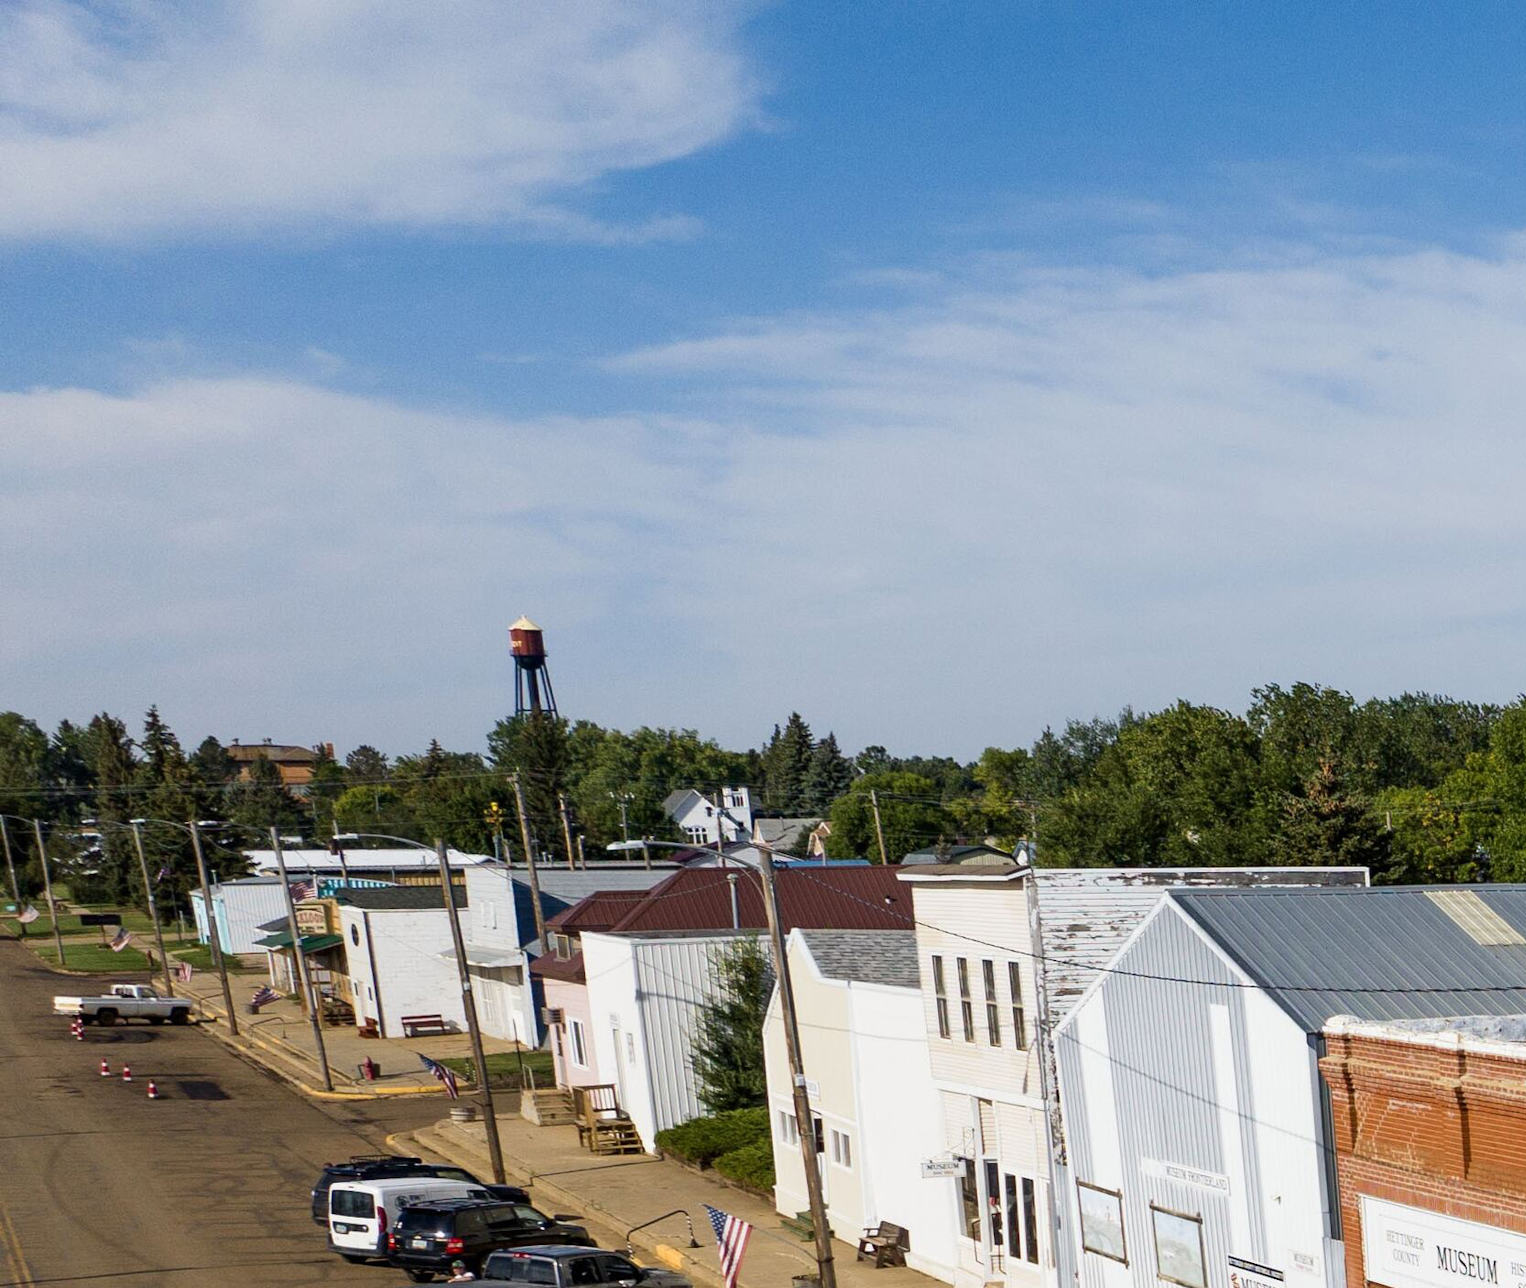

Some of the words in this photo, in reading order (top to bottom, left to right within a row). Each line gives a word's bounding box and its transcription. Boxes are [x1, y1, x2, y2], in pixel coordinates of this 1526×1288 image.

[1386, 1230, 1425, 1251] HETTINGER
[1392, 1249, 1421, 1267] COUNTY
[1436, 1245, 1499, 1285] MUSEUM
